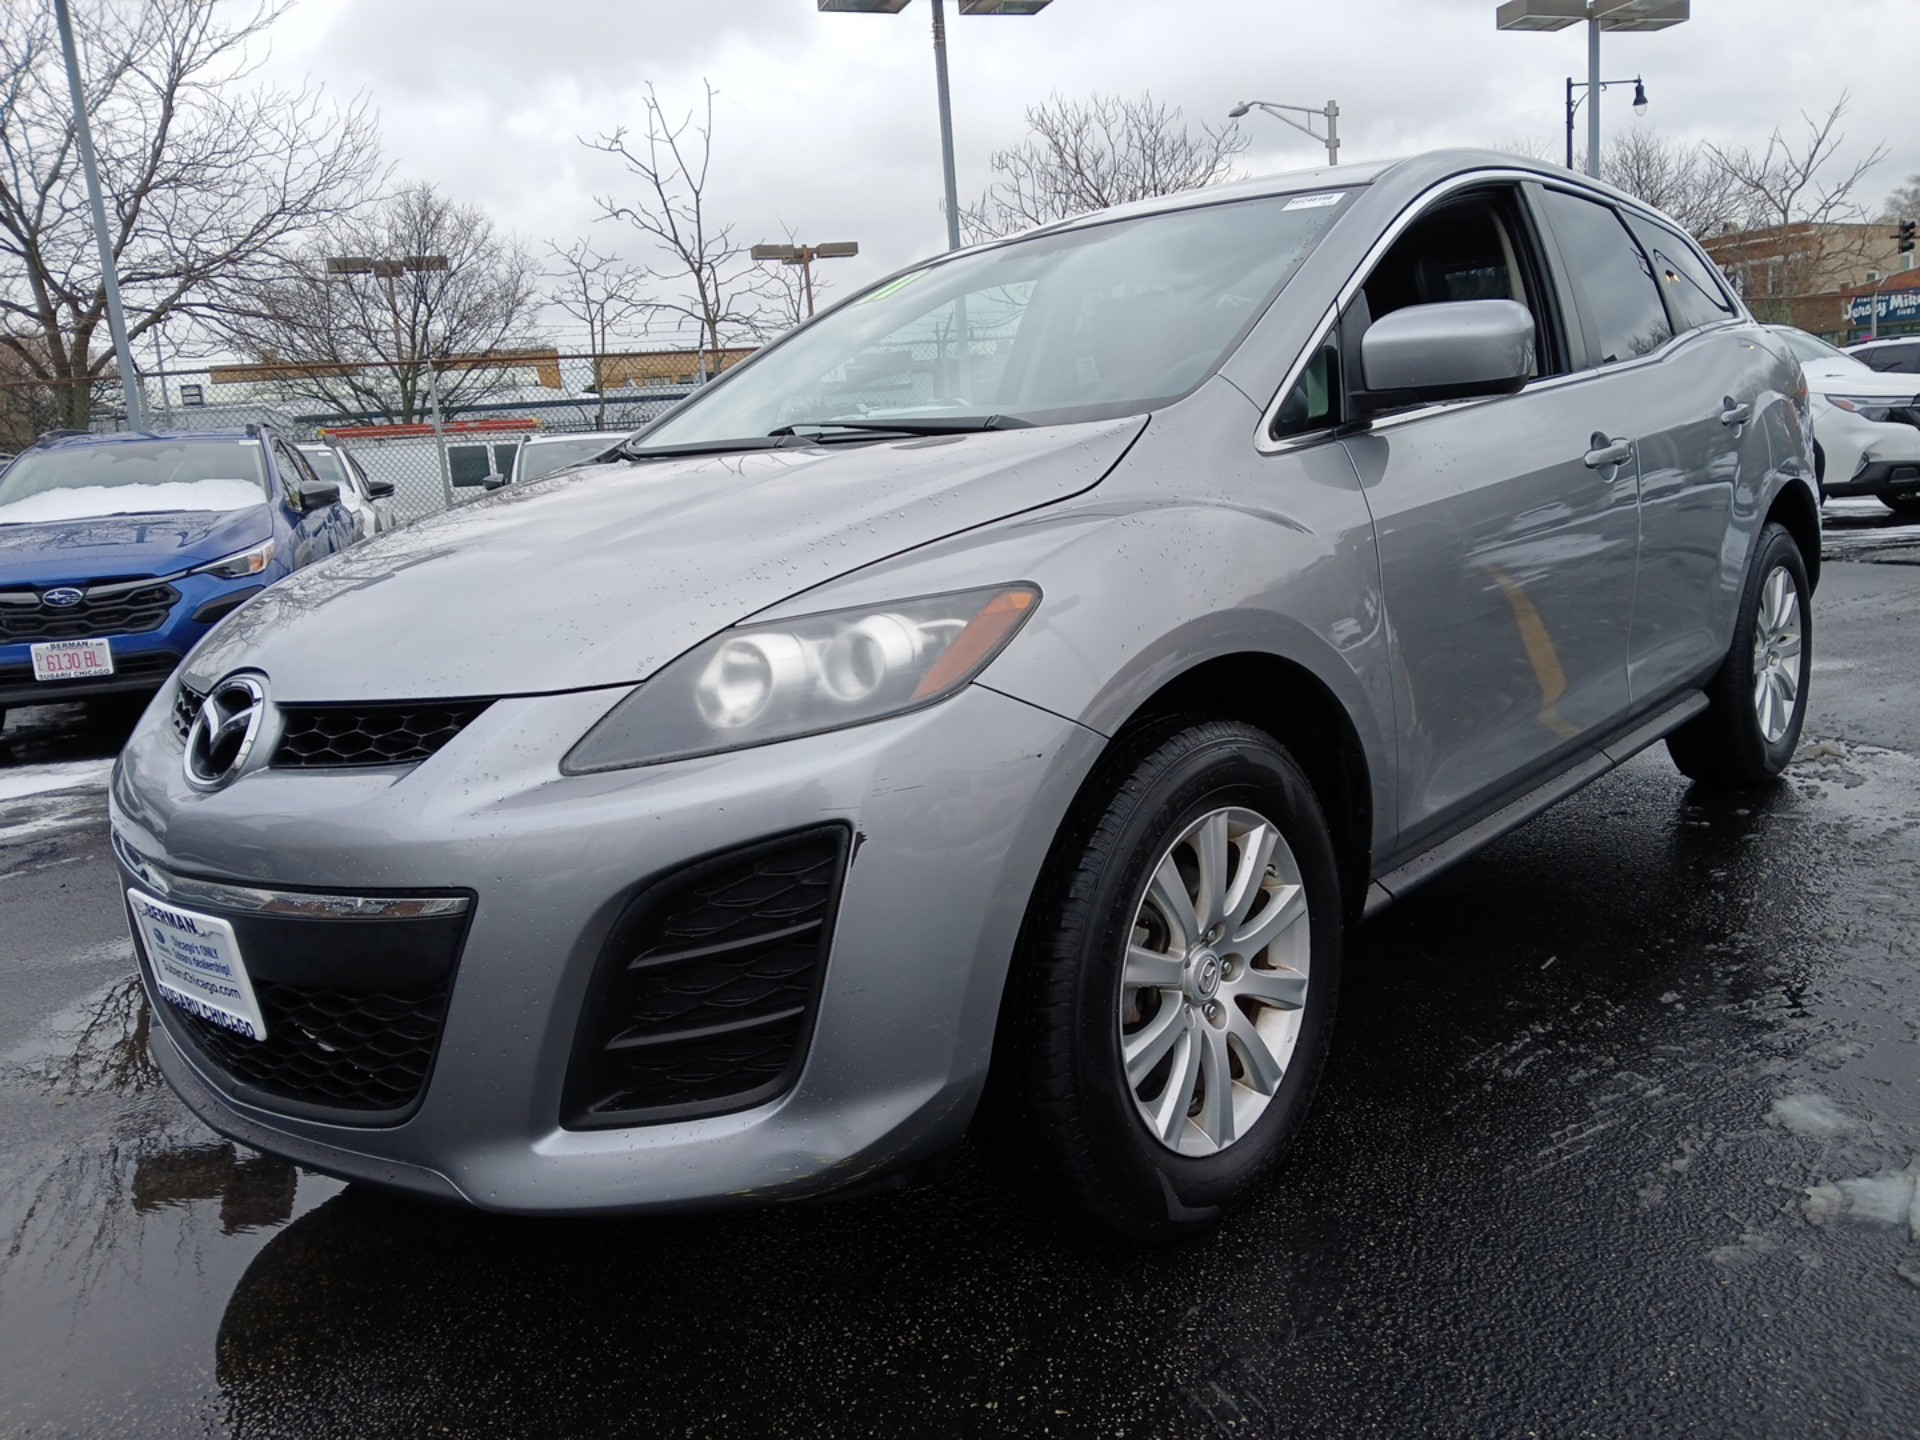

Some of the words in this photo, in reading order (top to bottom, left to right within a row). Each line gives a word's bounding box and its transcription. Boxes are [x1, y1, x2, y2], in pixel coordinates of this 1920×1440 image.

[1842, 302, 1887, 320] Jersy
[50, 641, 89, 650] BERMAN
[46, 652, 81, 672] 6130
[84, 651, 102, 668] BL
[39, 671, 72, 680] SUBARU
[73, 668, 110, 677] CHICAGO
[158, 983, 200, 1015] SUBARU
[202, 1004, 255, 1039] CHICAGO
